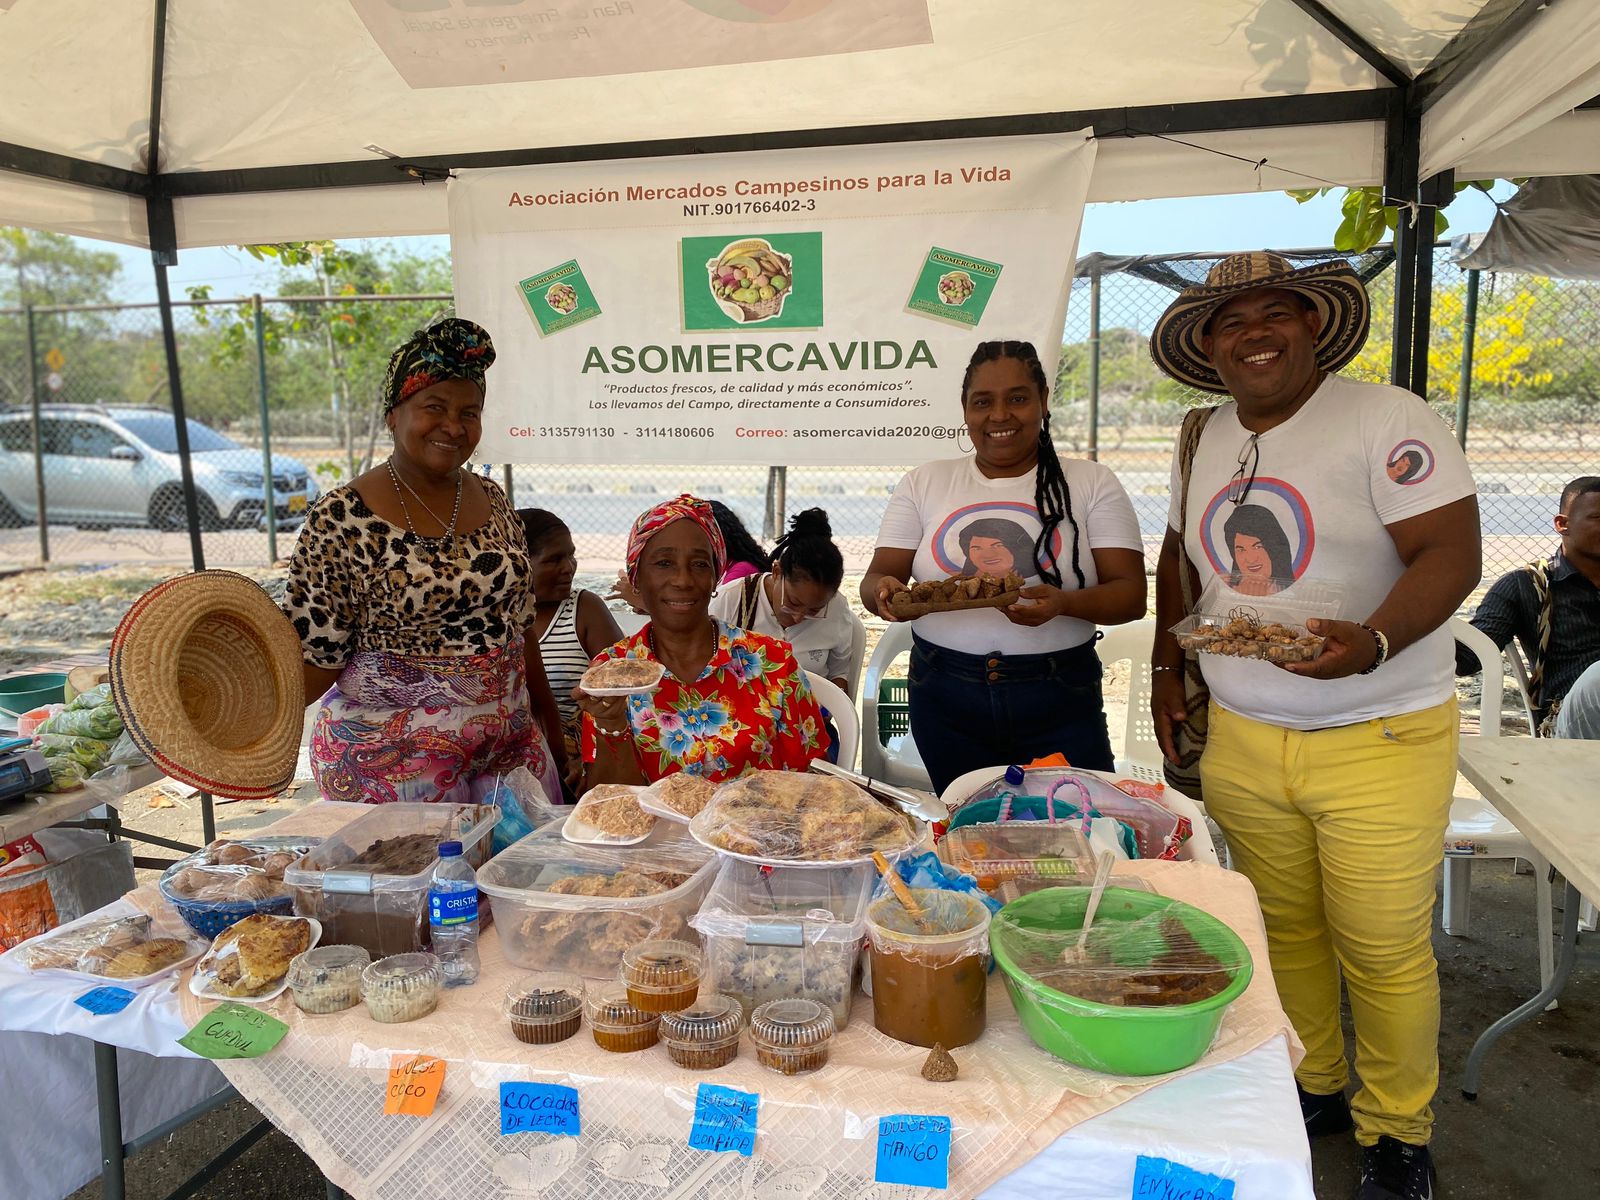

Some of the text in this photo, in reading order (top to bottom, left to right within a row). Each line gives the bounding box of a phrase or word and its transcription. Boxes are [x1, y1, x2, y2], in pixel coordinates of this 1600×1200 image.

[508, 166, 1012, 207] Asociación Mercados Campesinos para la Vida
[683, 198, 816, 217] NIT.901766402-3
[932, 252, 997, 275] ASOMERCAVIDA
[581, 339, 938, 374] ASOMERCAVIDA
[603, 383, 668, 395] “Productos
[671, 383, 717, 396] frescos,
[720, 383, 736, 394] de
[738, 382, 784, 393] calidad
[787, 383, 794, 395] y
[797, 381, 824, 392] más
[588, 396, 931, 412] Los llevamos del Campo, directamente a Consumidores.
[508, 426, 536, 438] Cel:
[539, 426, 615, 438] 3135791130
[635, 426, 715, 438] 3114180606
[735, 426, 789, 438] Correo:
[446, 894, 478, 909] CRISTAL
[390, 1084, 426, 1098] COCO
[506, 1112, 526, 1131] DE
[879, 1120, 926, 1137] DULCE
[884, 1140, 939, 1162] MANGO
[1138, 1174, 1226, 1200] ENYUCAD
